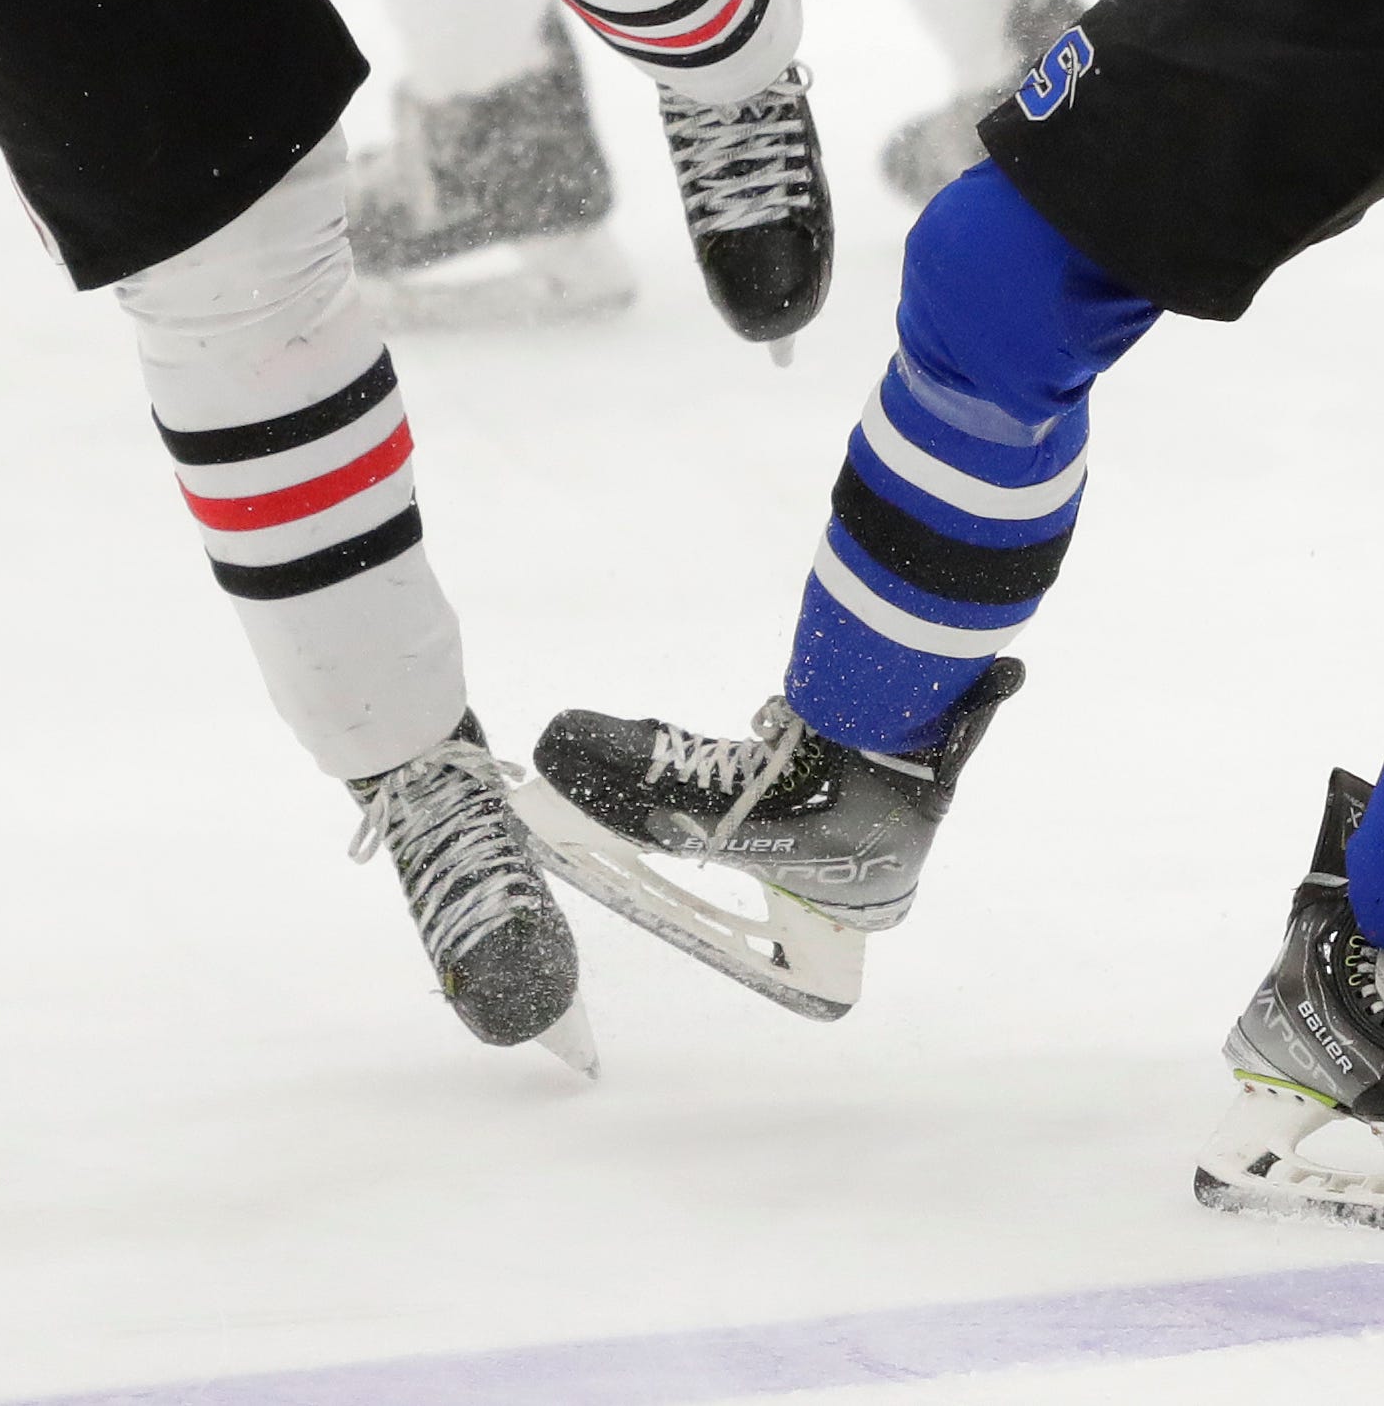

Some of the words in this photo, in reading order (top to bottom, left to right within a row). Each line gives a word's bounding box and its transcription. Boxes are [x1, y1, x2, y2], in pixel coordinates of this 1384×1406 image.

[1014, 24, 1096, 123] S
[683, 836, 796, 854] BUER
[1297, 1000, 1353, 1075] BAUER
